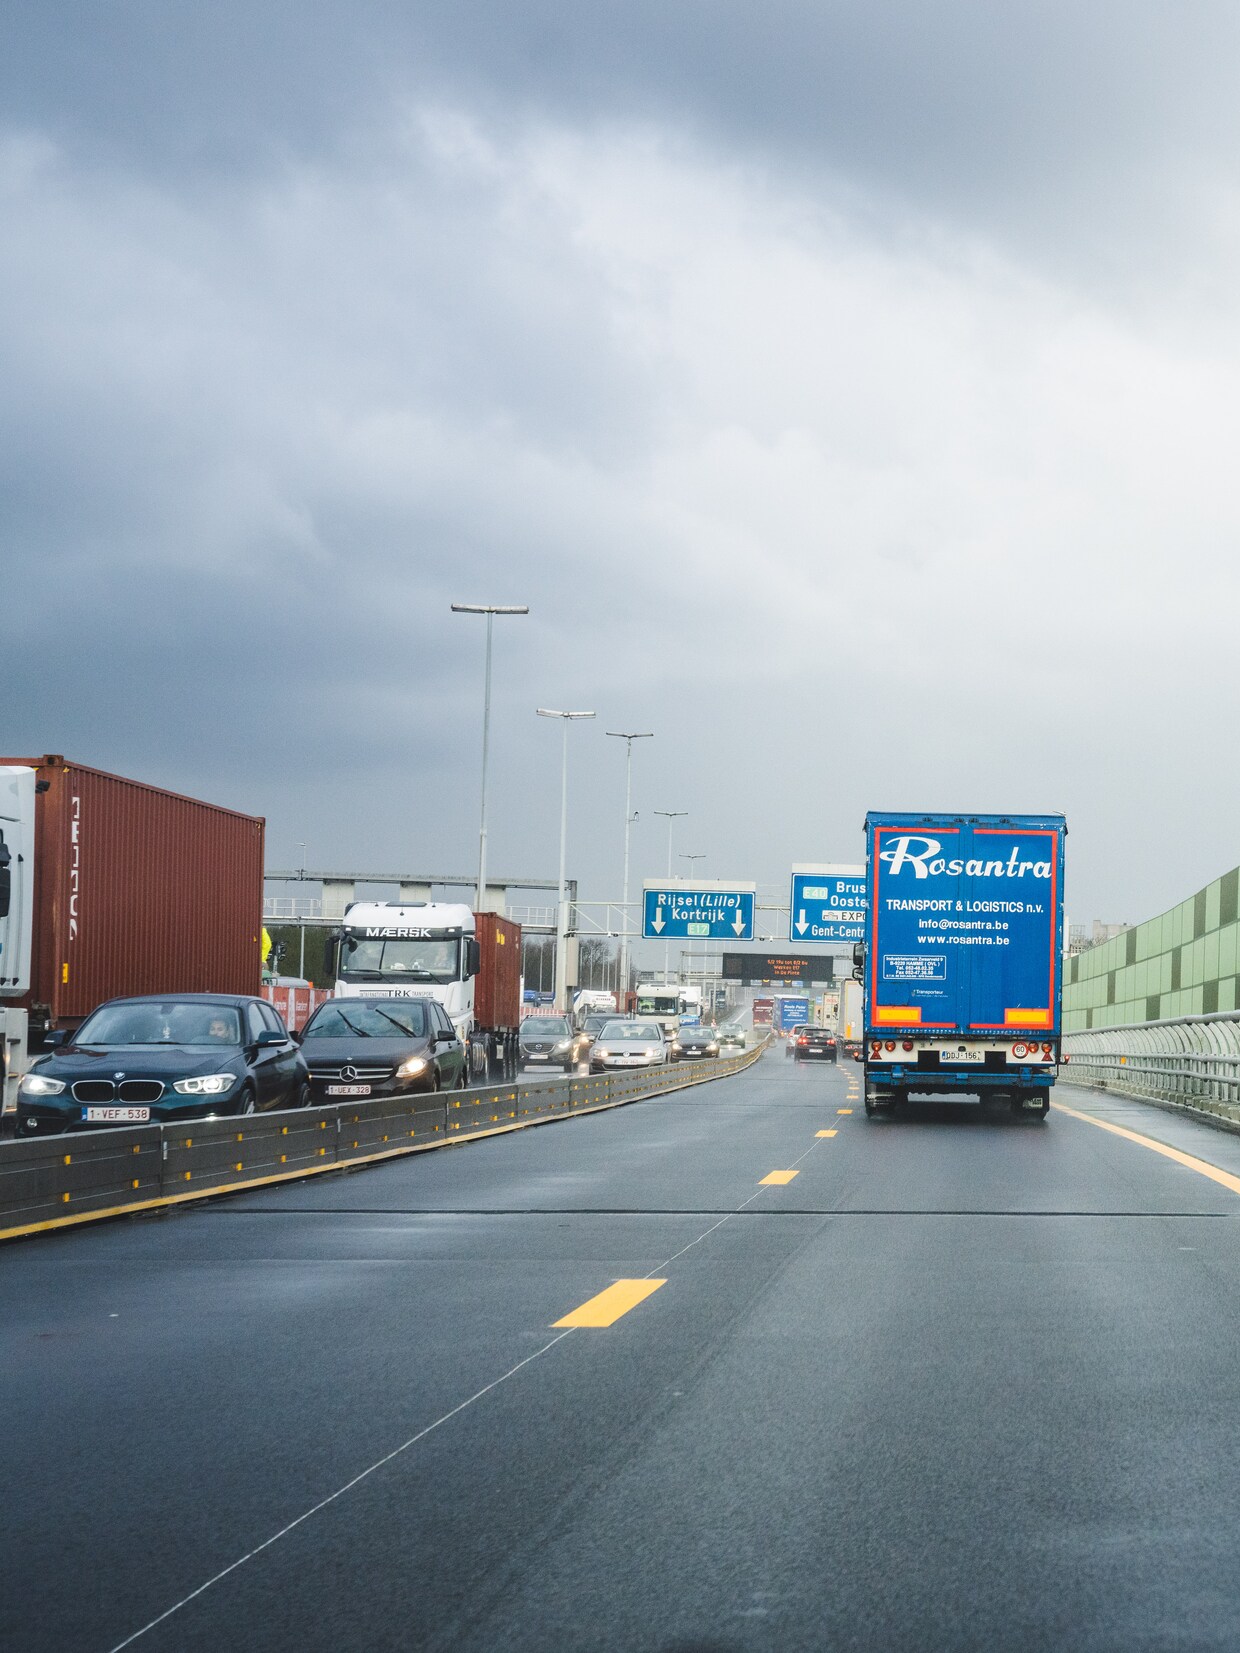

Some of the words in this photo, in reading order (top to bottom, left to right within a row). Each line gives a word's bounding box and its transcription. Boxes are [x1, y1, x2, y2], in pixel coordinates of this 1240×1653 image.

[879, 836, 1052, 879] Rosantra
[804, 888, 826, 897] E40
[658, 894, 698, 908] Rijsel
[700, 894, 741, 908] (Lille)
[886, 899, 953, 911] TRANSPORT
[955, 901, 963, 911] &
[966, 901, 1024, 913] LOGISTICS
[1026, 903, 1044, 913] n.v.
[672, 908, 725, 923] Kortrijk
[366, 927, 432, 938] MÆRSK
[689, 925, 708, 934] E17
[917, 934, 1010, 946] www.rosantra.be
[388, 989, 411, 998] TRK
[1016, 1045, 1025, 1053] 60
[90, 1109, 148, 1119] 1-VEF-538
